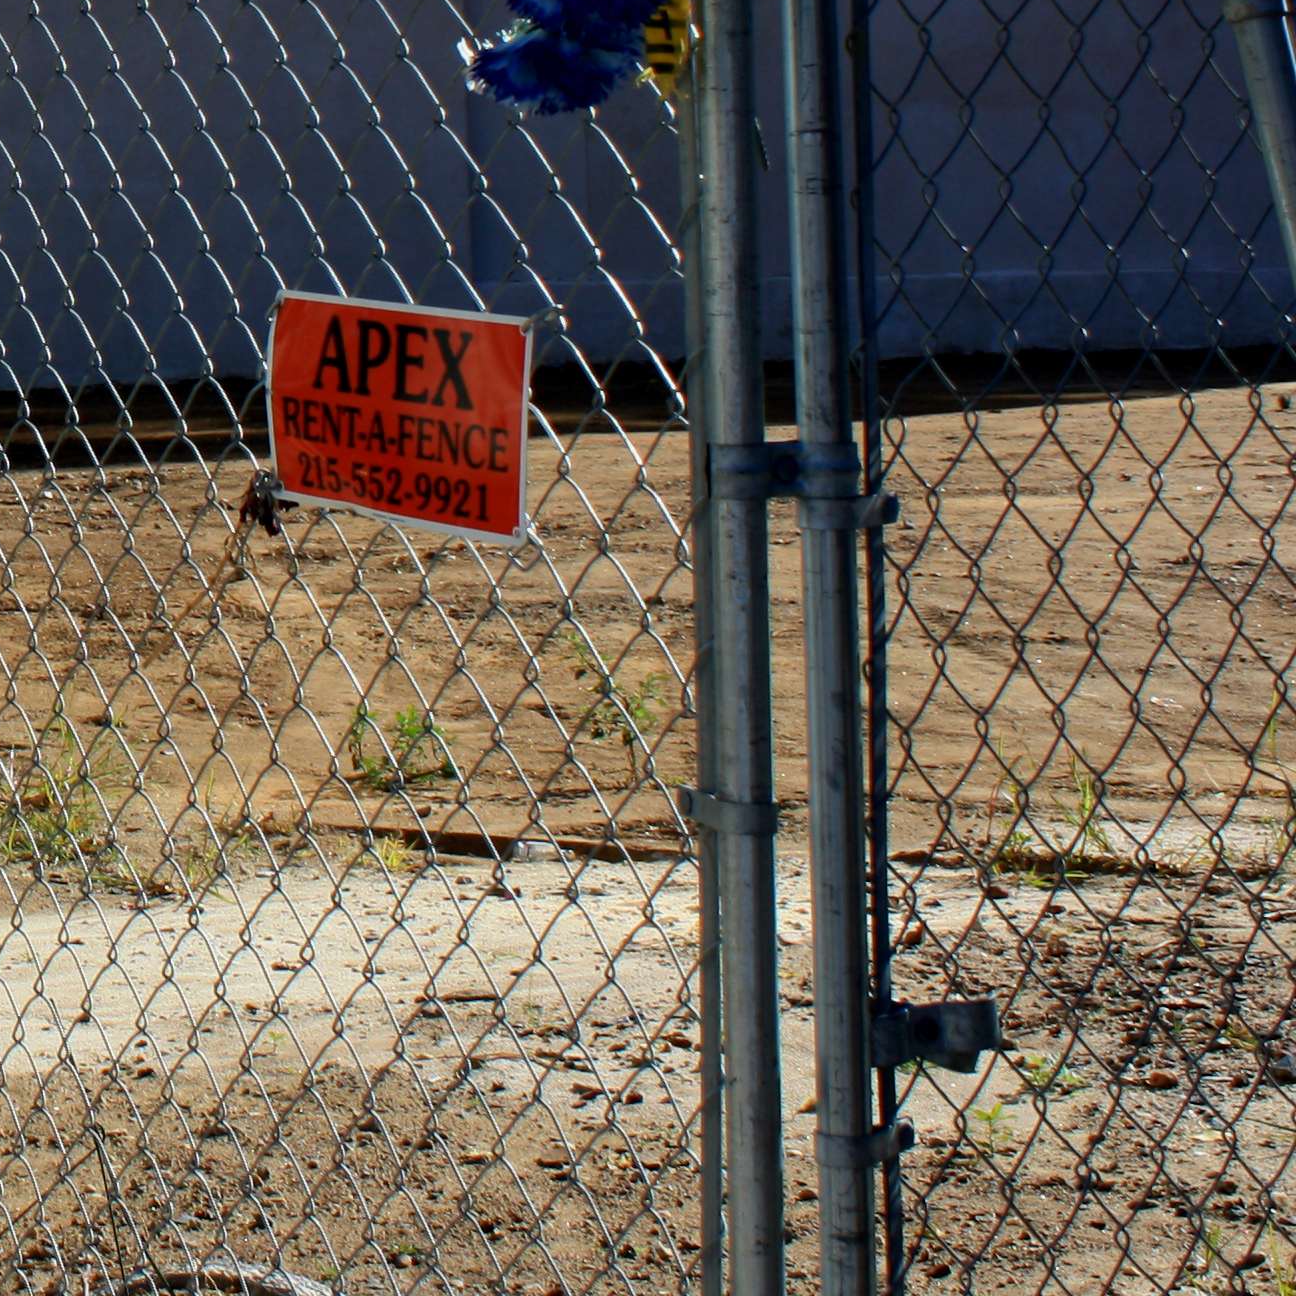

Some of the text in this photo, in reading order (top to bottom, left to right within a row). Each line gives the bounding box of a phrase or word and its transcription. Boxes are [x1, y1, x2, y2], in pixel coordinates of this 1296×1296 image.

[311, 314, 475, 411] APEX
[282, 396, 510, 473] RENT-A-FENCE
[298, 452, 491, 522] 215-552-9921
